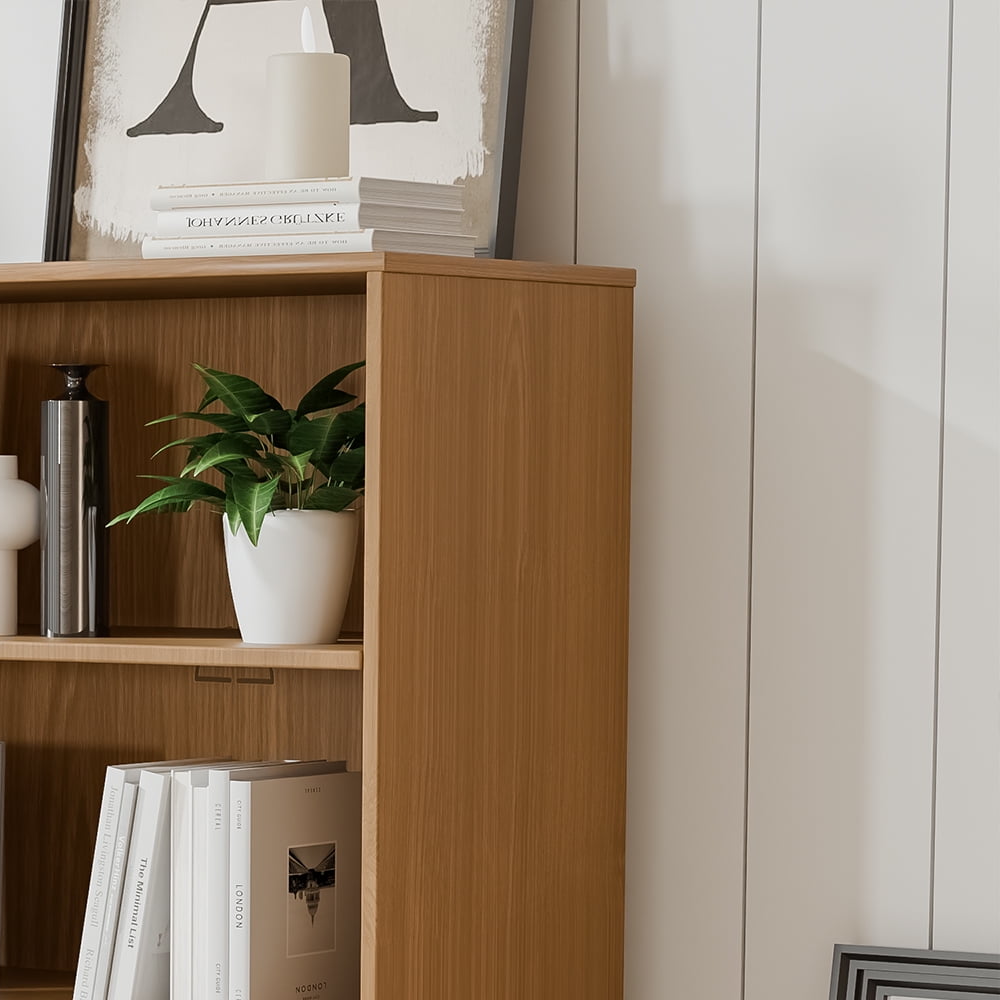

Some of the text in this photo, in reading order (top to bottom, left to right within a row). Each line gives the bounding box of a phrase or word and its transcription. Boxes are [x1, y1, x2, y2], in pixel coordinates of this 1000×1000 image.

[90, 890, 104, 928] Seagull
[127, 857, 148, 949] The Minimal List
[235, 884, 244, 929] LONDON
[82, 949, 95, 988] Richard
[295, 981, 328, 994] LONDON
